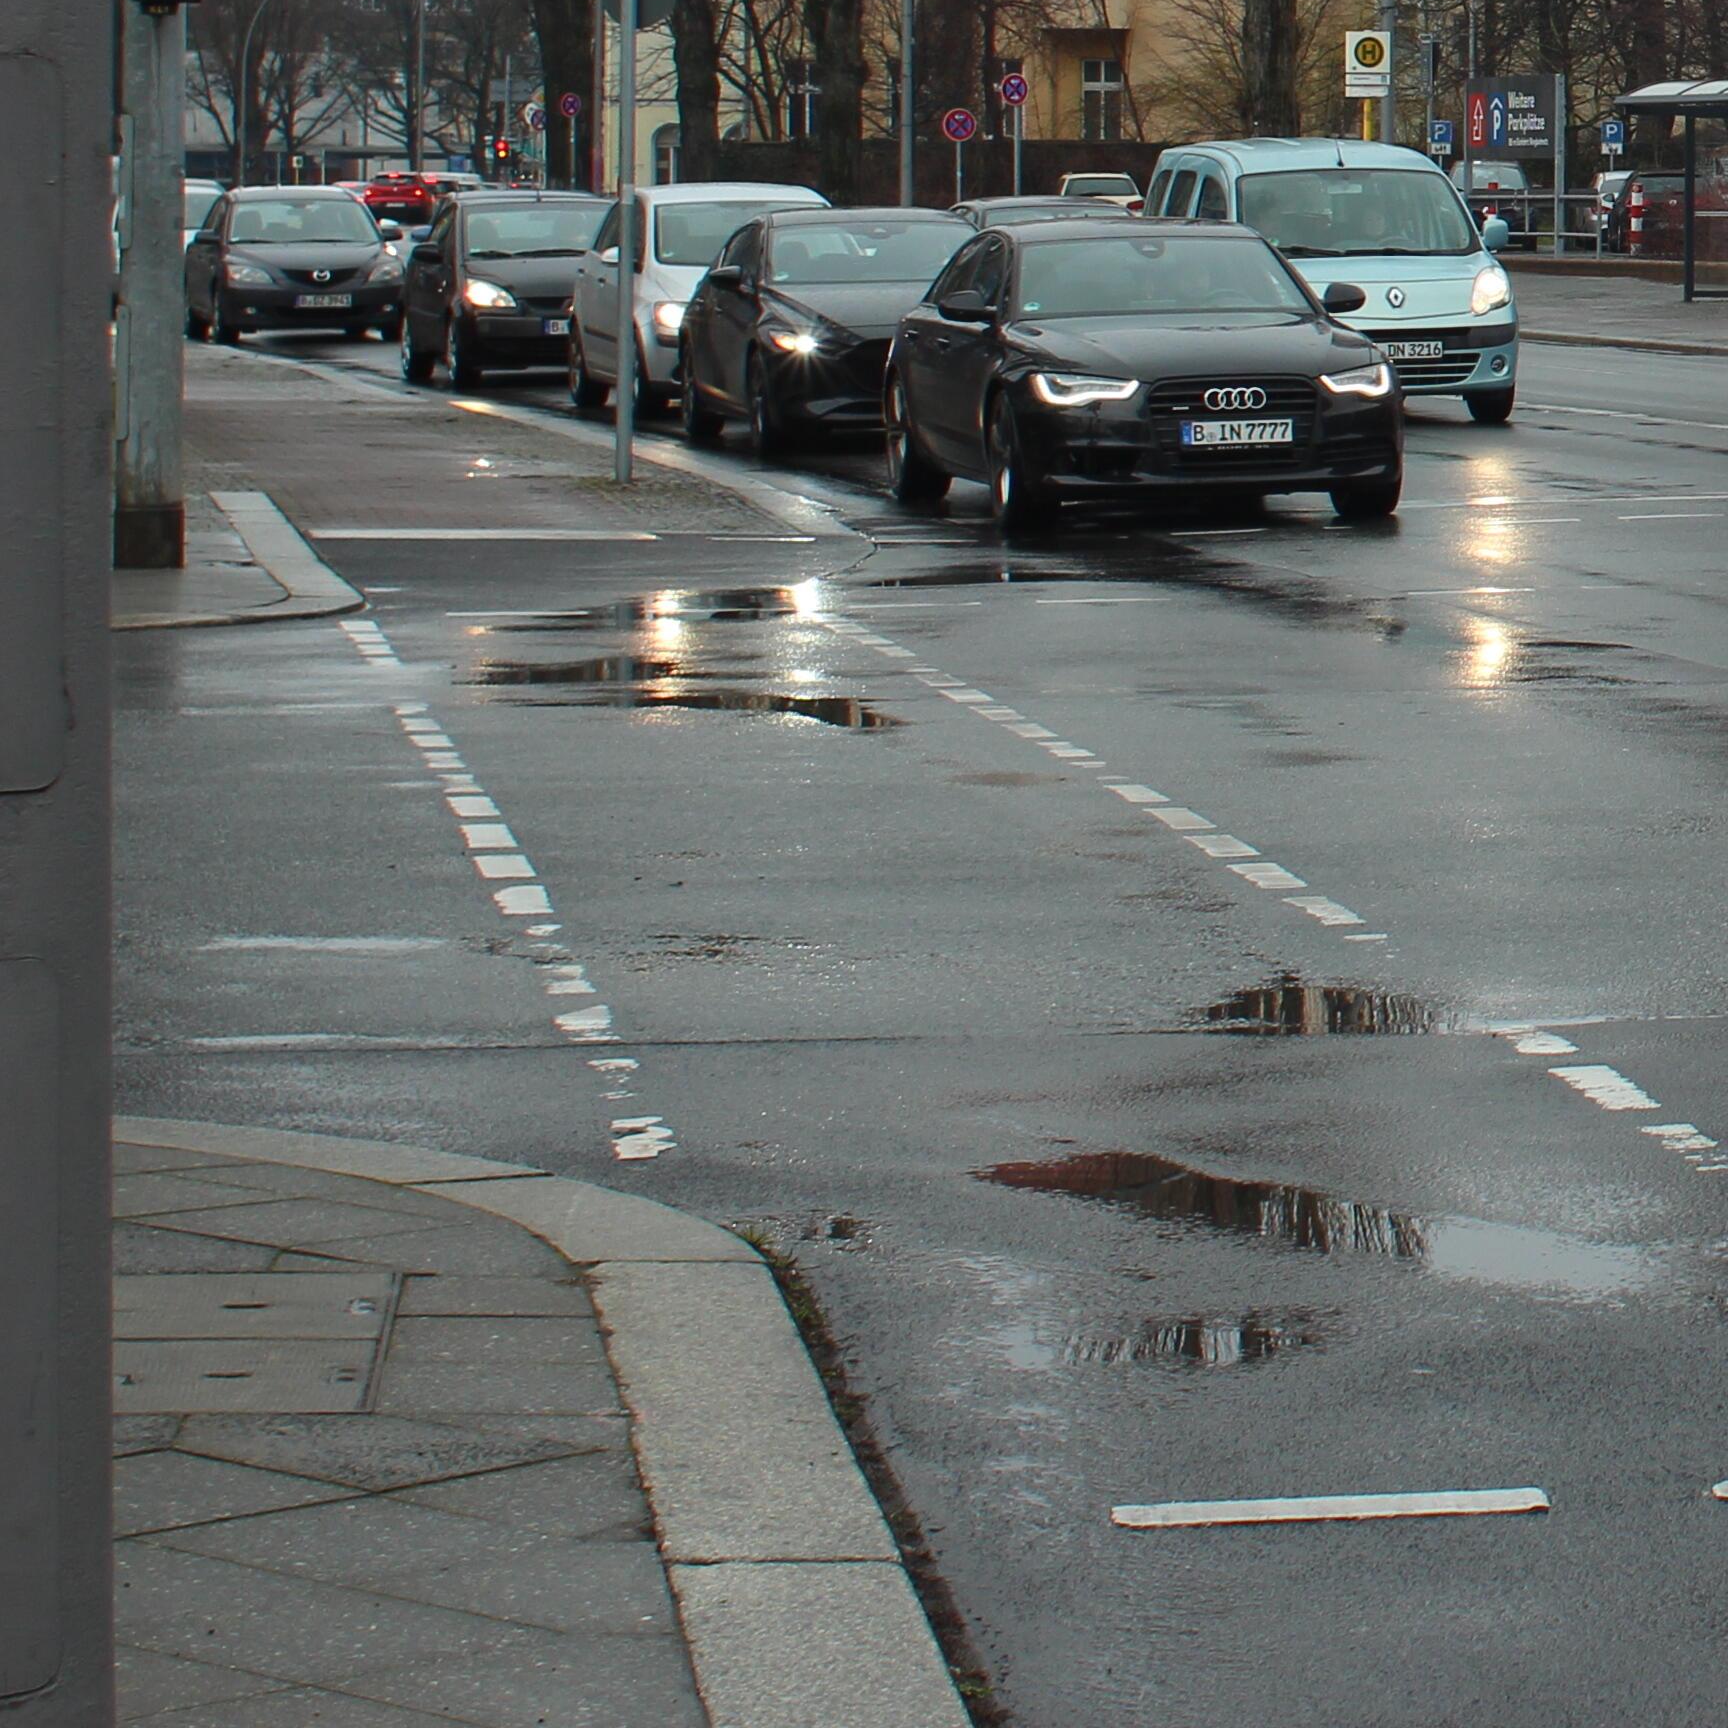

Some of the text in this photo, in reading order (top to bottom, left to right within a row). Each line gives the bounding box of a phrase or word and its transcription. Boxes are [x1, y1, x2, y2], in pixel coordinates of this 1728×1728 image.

[1507, 91, 1535, 109] Weitere
[1387, 343, 1441, 357] DN 3216
[1193, 422, 1290, 442] B IN 7777
